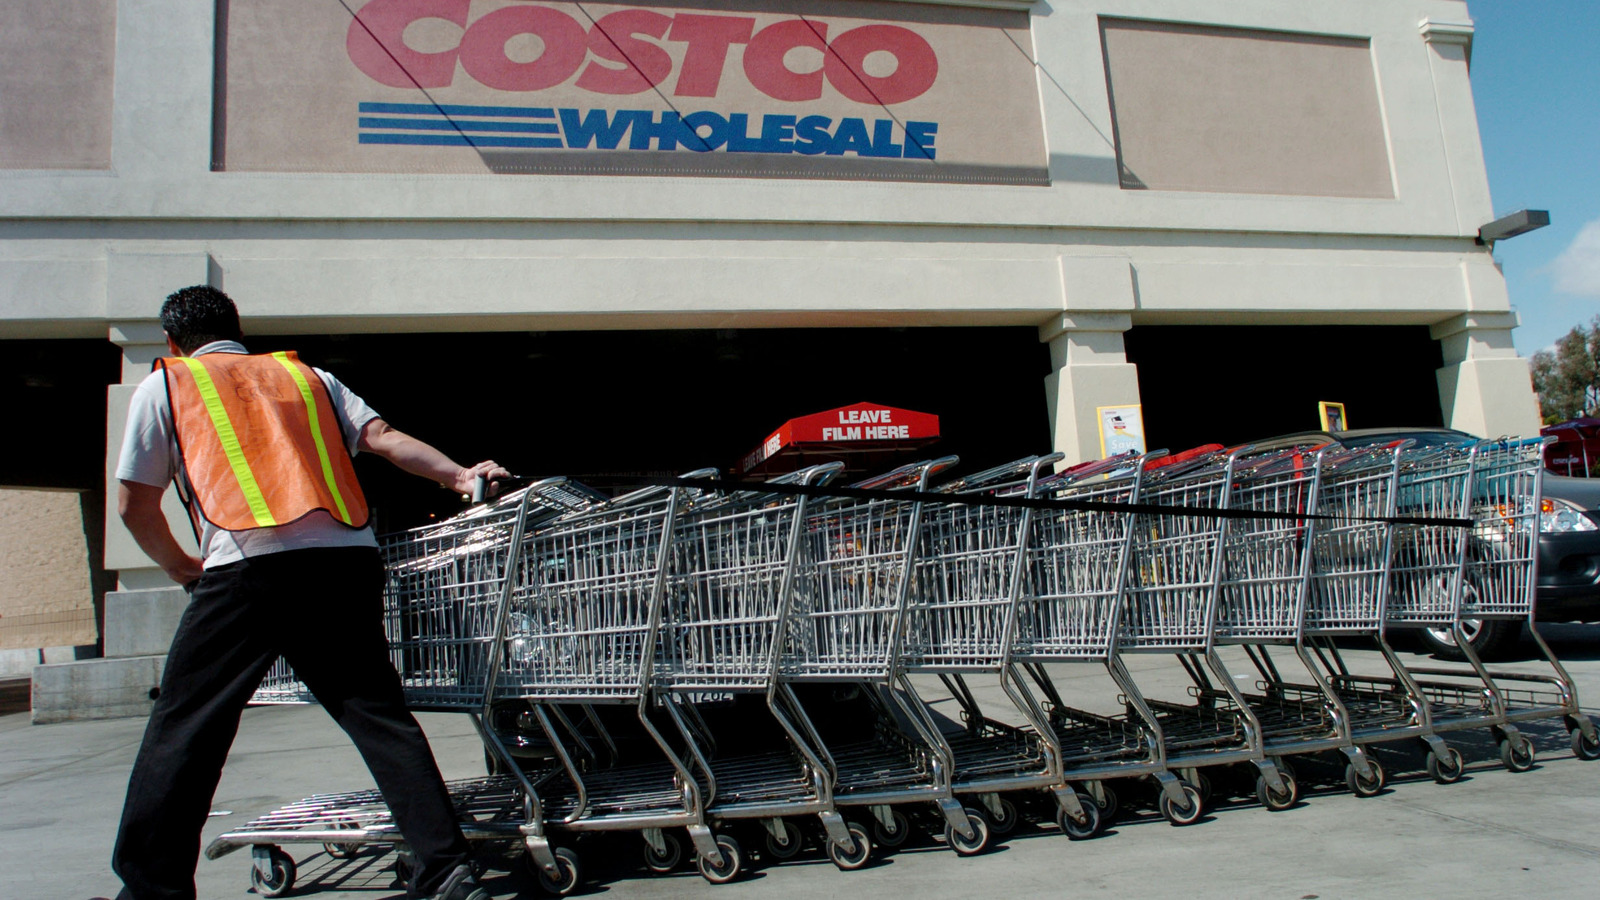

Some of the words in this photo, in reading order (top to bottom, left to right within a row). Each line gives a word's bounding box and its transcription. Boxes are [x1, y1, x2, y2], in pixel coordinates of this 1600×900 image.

[346, 0, 939, 105] COSTCO
[558, 108, 938, 160] WHOLESALE
[838, 410, 892, 424] LEAVE
[822, 426, 861, 441] FILM
[865, 425, 909, 440] HERE
[1111, 440, 1138, 450] Save
